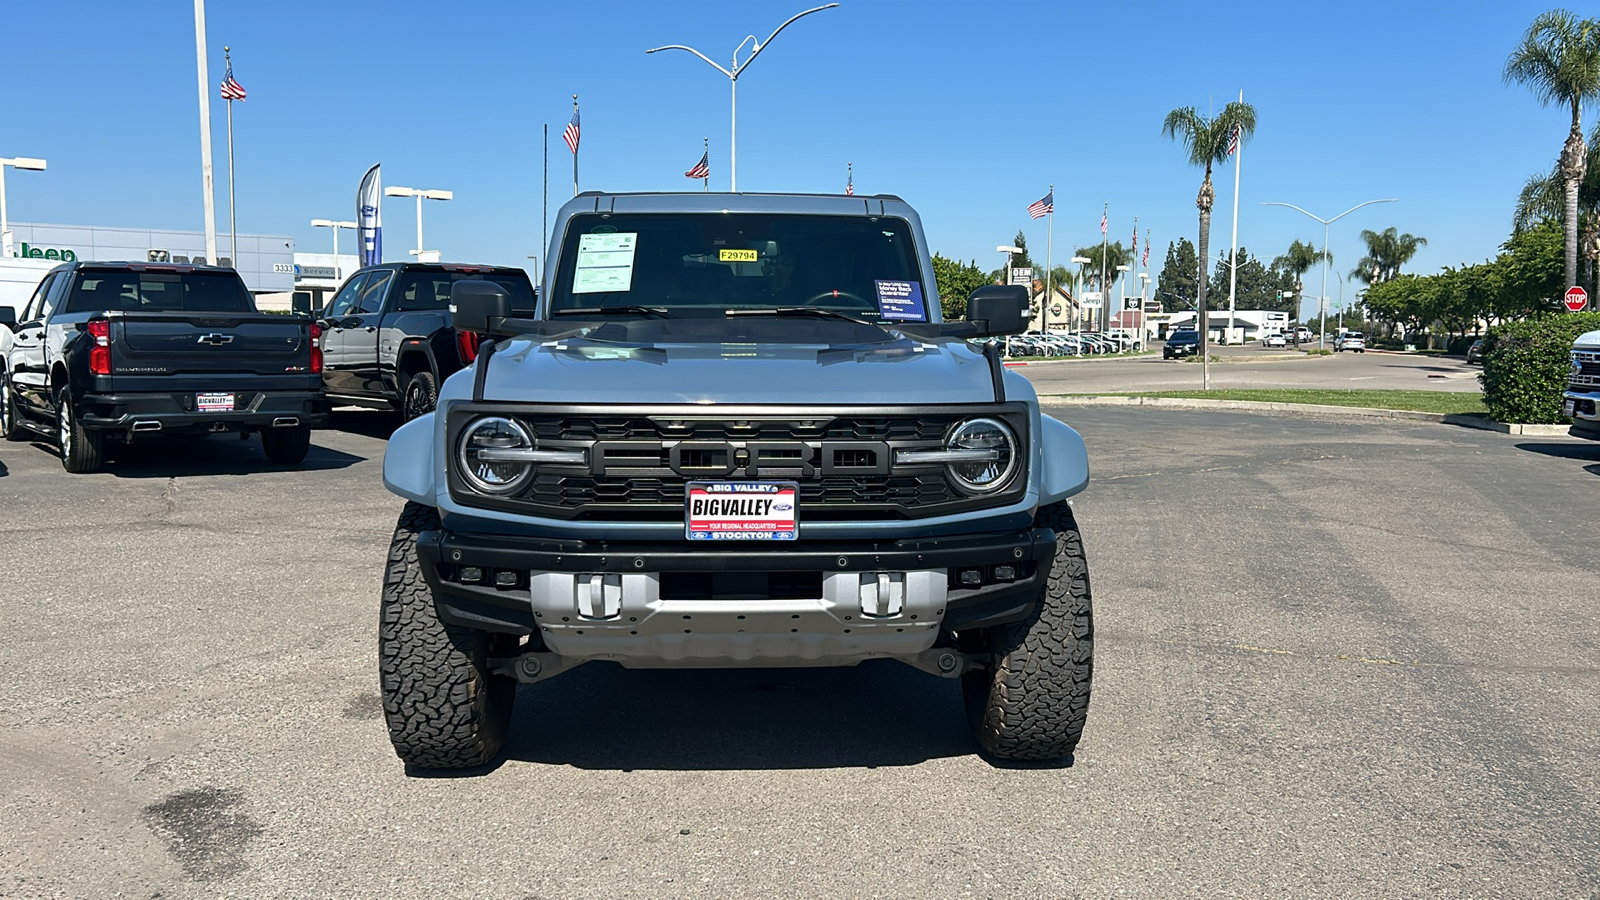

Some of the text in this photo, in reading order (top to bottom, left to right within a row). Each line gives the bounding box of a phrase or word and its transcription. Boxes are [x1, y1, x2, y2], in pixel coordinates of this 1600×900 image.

[13, 242, 76, 262] Jeep
[721, 251, 754, 260] F29794
[275, 264, 293, 273] 3333
[1012, 269, 1031, 277] OEM
[1566, 293, 1586, 304] STOP
[591, 440, 890, 476] FORD
[713, 484, 772, 492] BIG VALLEY
[712, 531, 773, 539] STOCKTON
